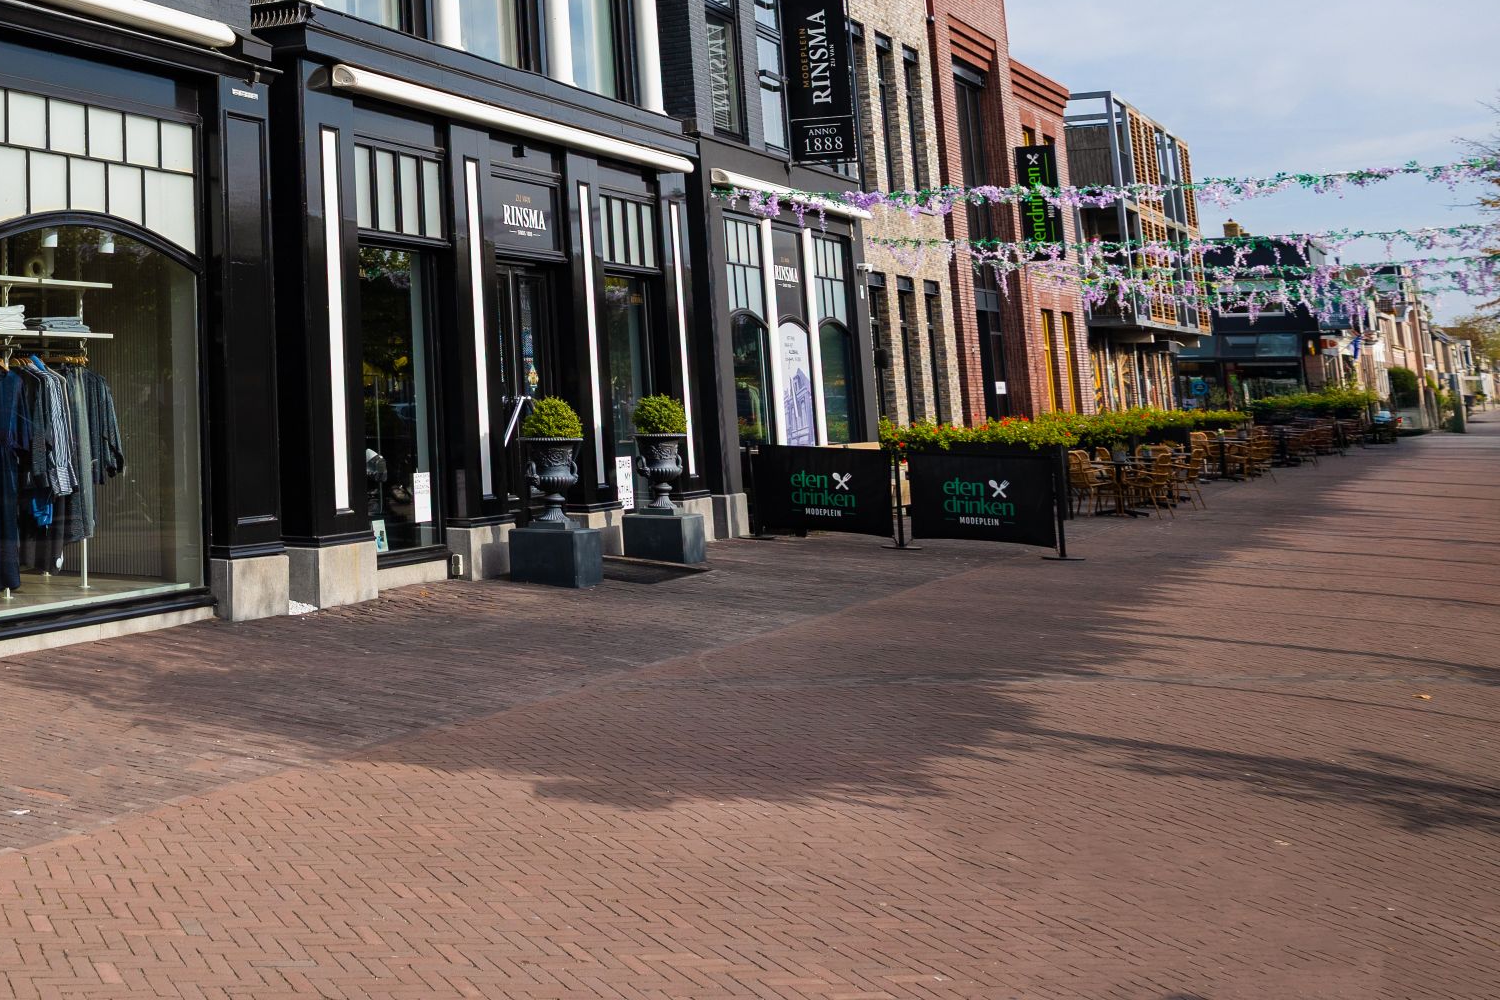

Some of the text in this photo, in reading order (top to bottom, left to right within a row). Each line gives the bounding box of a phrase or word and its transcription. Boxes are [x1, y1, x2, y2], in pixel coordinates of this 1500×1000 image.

[798, 28, 810, 88] MODEPLEIN
[806, 9, 832, 104] RINSMA
[808, 127, 836, 136] ANNO
[804, 136, 843, 152] 1888
[502, 204, 547, 231] RINSMA
[790, 470, 828, 488] eten
[943, 477, 985, 497] eten
[791, 488, 856, 508] drinken
[944, 496, 1015, 517] drinken
[805, 507, 842, 517] MODEPLEIN
[959, 516, 1000, 526] MODEPLEIN
